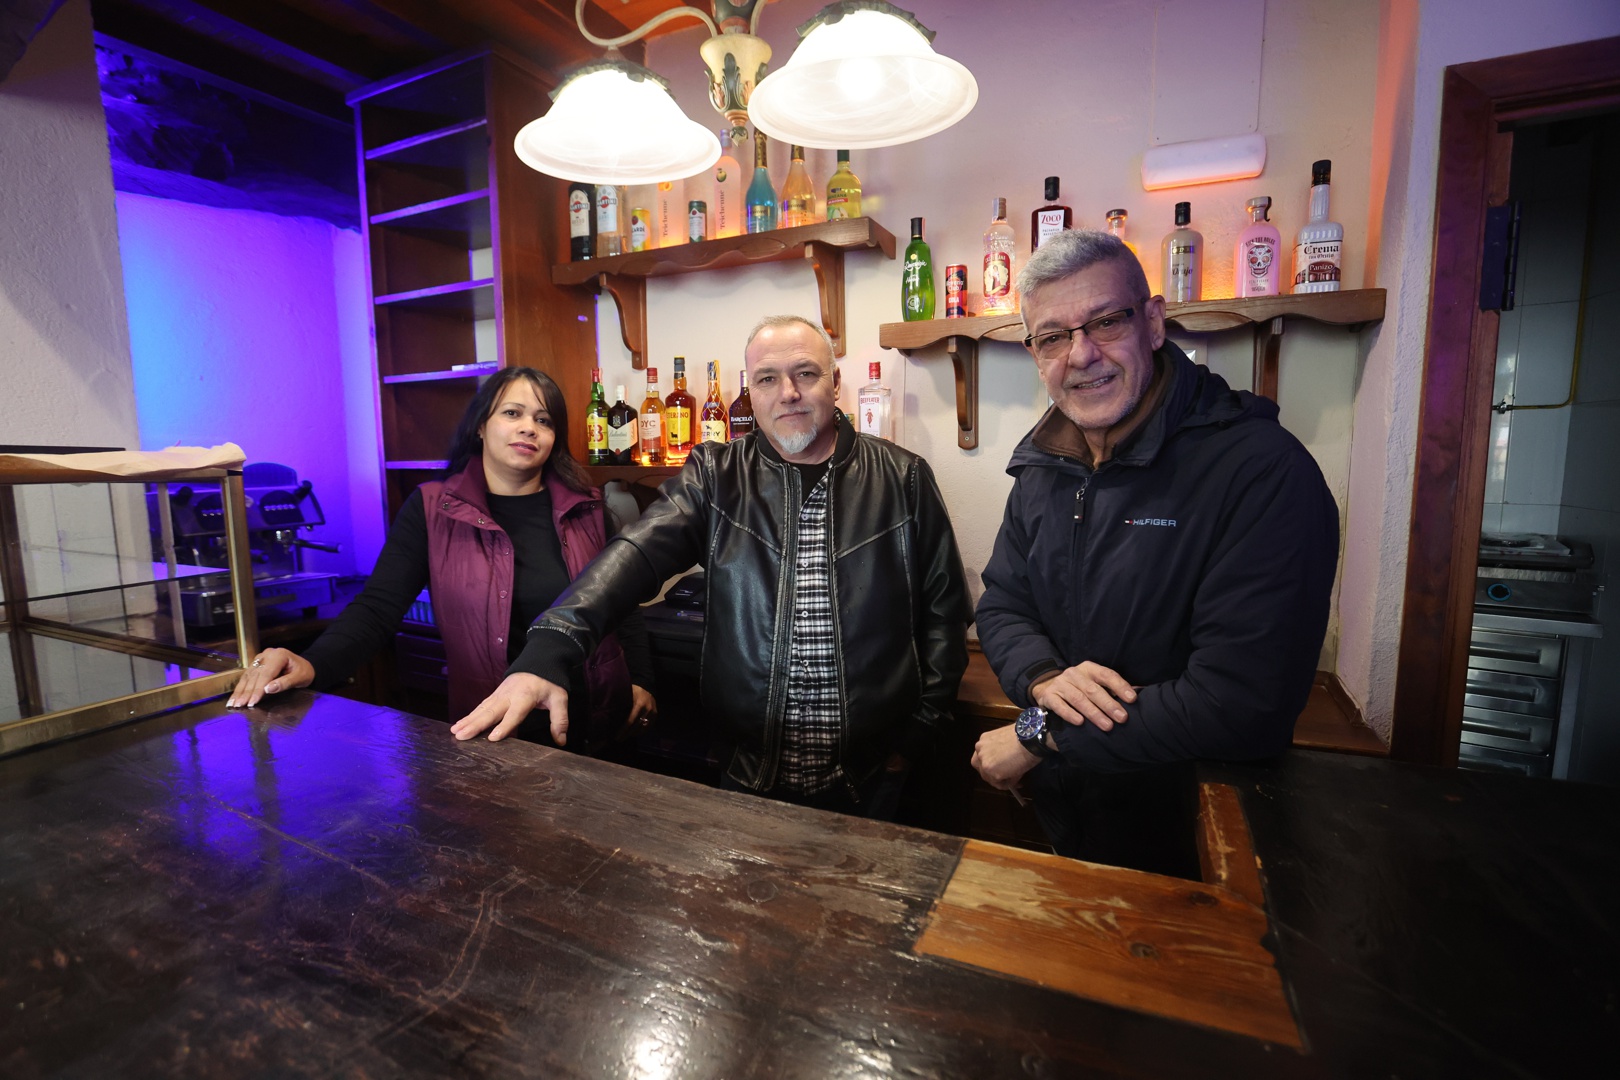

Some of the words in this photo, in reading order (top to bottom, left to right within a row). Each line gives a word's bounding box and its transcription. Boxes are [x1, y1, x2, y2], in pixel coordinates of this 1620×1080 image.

[1041, 214, 1061, 224] ZOCO
[1304, 245, 1339, 254] Crema
[1133, 518, 1177, 527] HILFIGER
